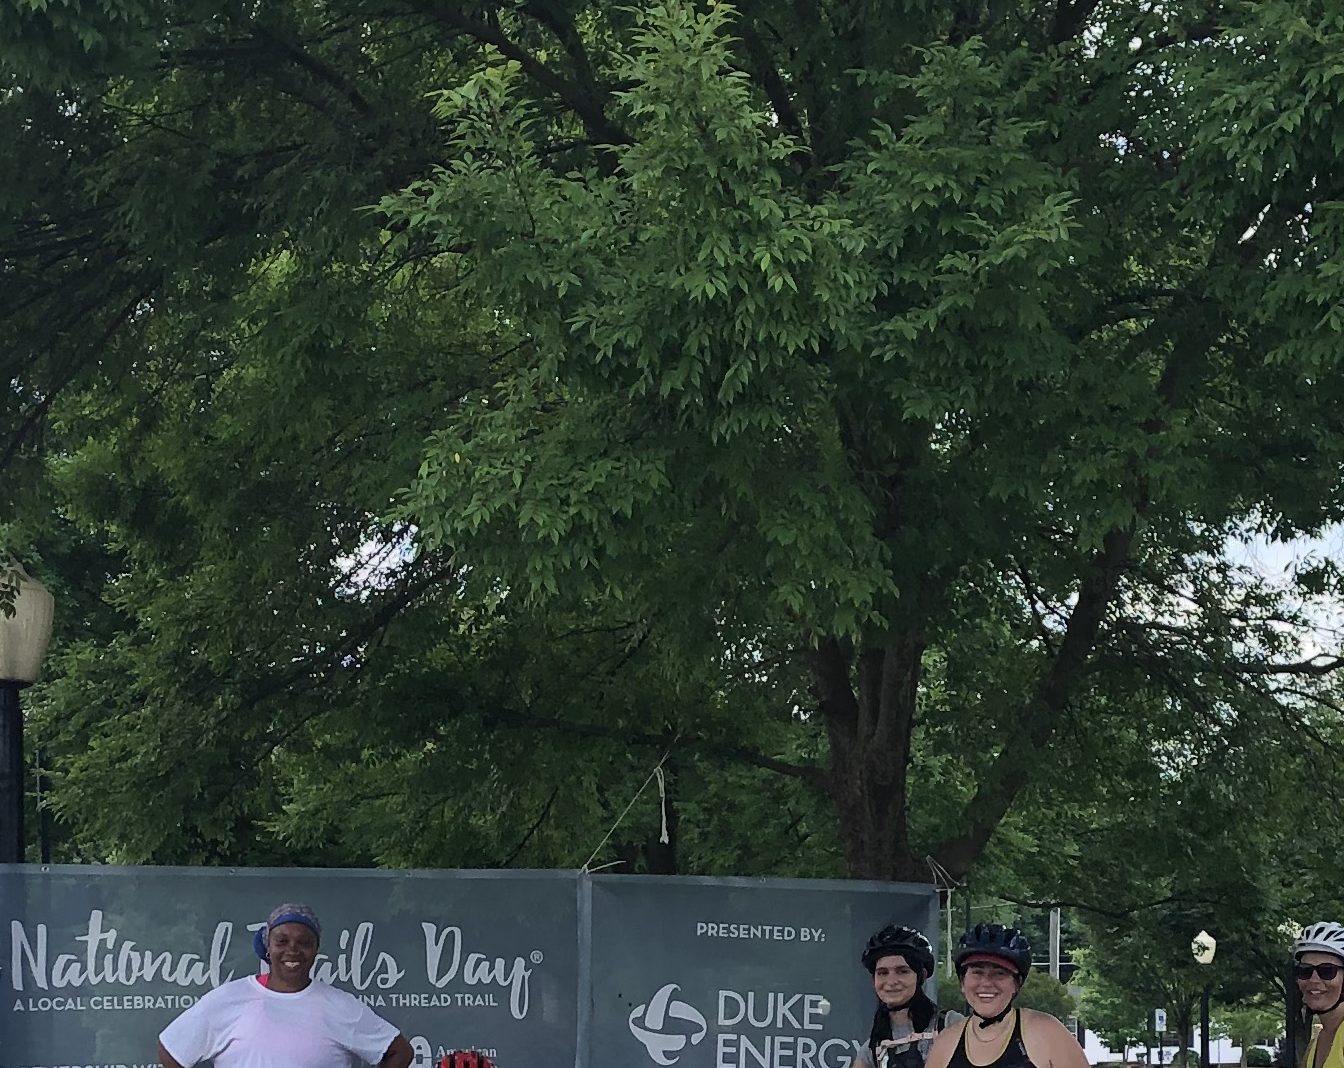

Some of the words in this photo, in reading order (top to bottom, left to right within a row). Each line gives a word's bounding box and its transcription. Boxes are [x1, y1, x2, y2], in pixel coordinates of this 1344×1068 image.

[696, 922, 796, 941] PRESENTED
[800, 927, 826, 942] BY:
[11, 909, 234, 991] National
[246, 922, 405, 991] ails
[13, 998, 25, 1012] A
[28, 996, 87, 1012] LOCAL
[389, 993, 452, 1008] THREAD
[454, 993, 499, 1007] TRAIL
[718, 989, 824, 1031] DUKE
[436, 1045, 498, 1058] Amrian
